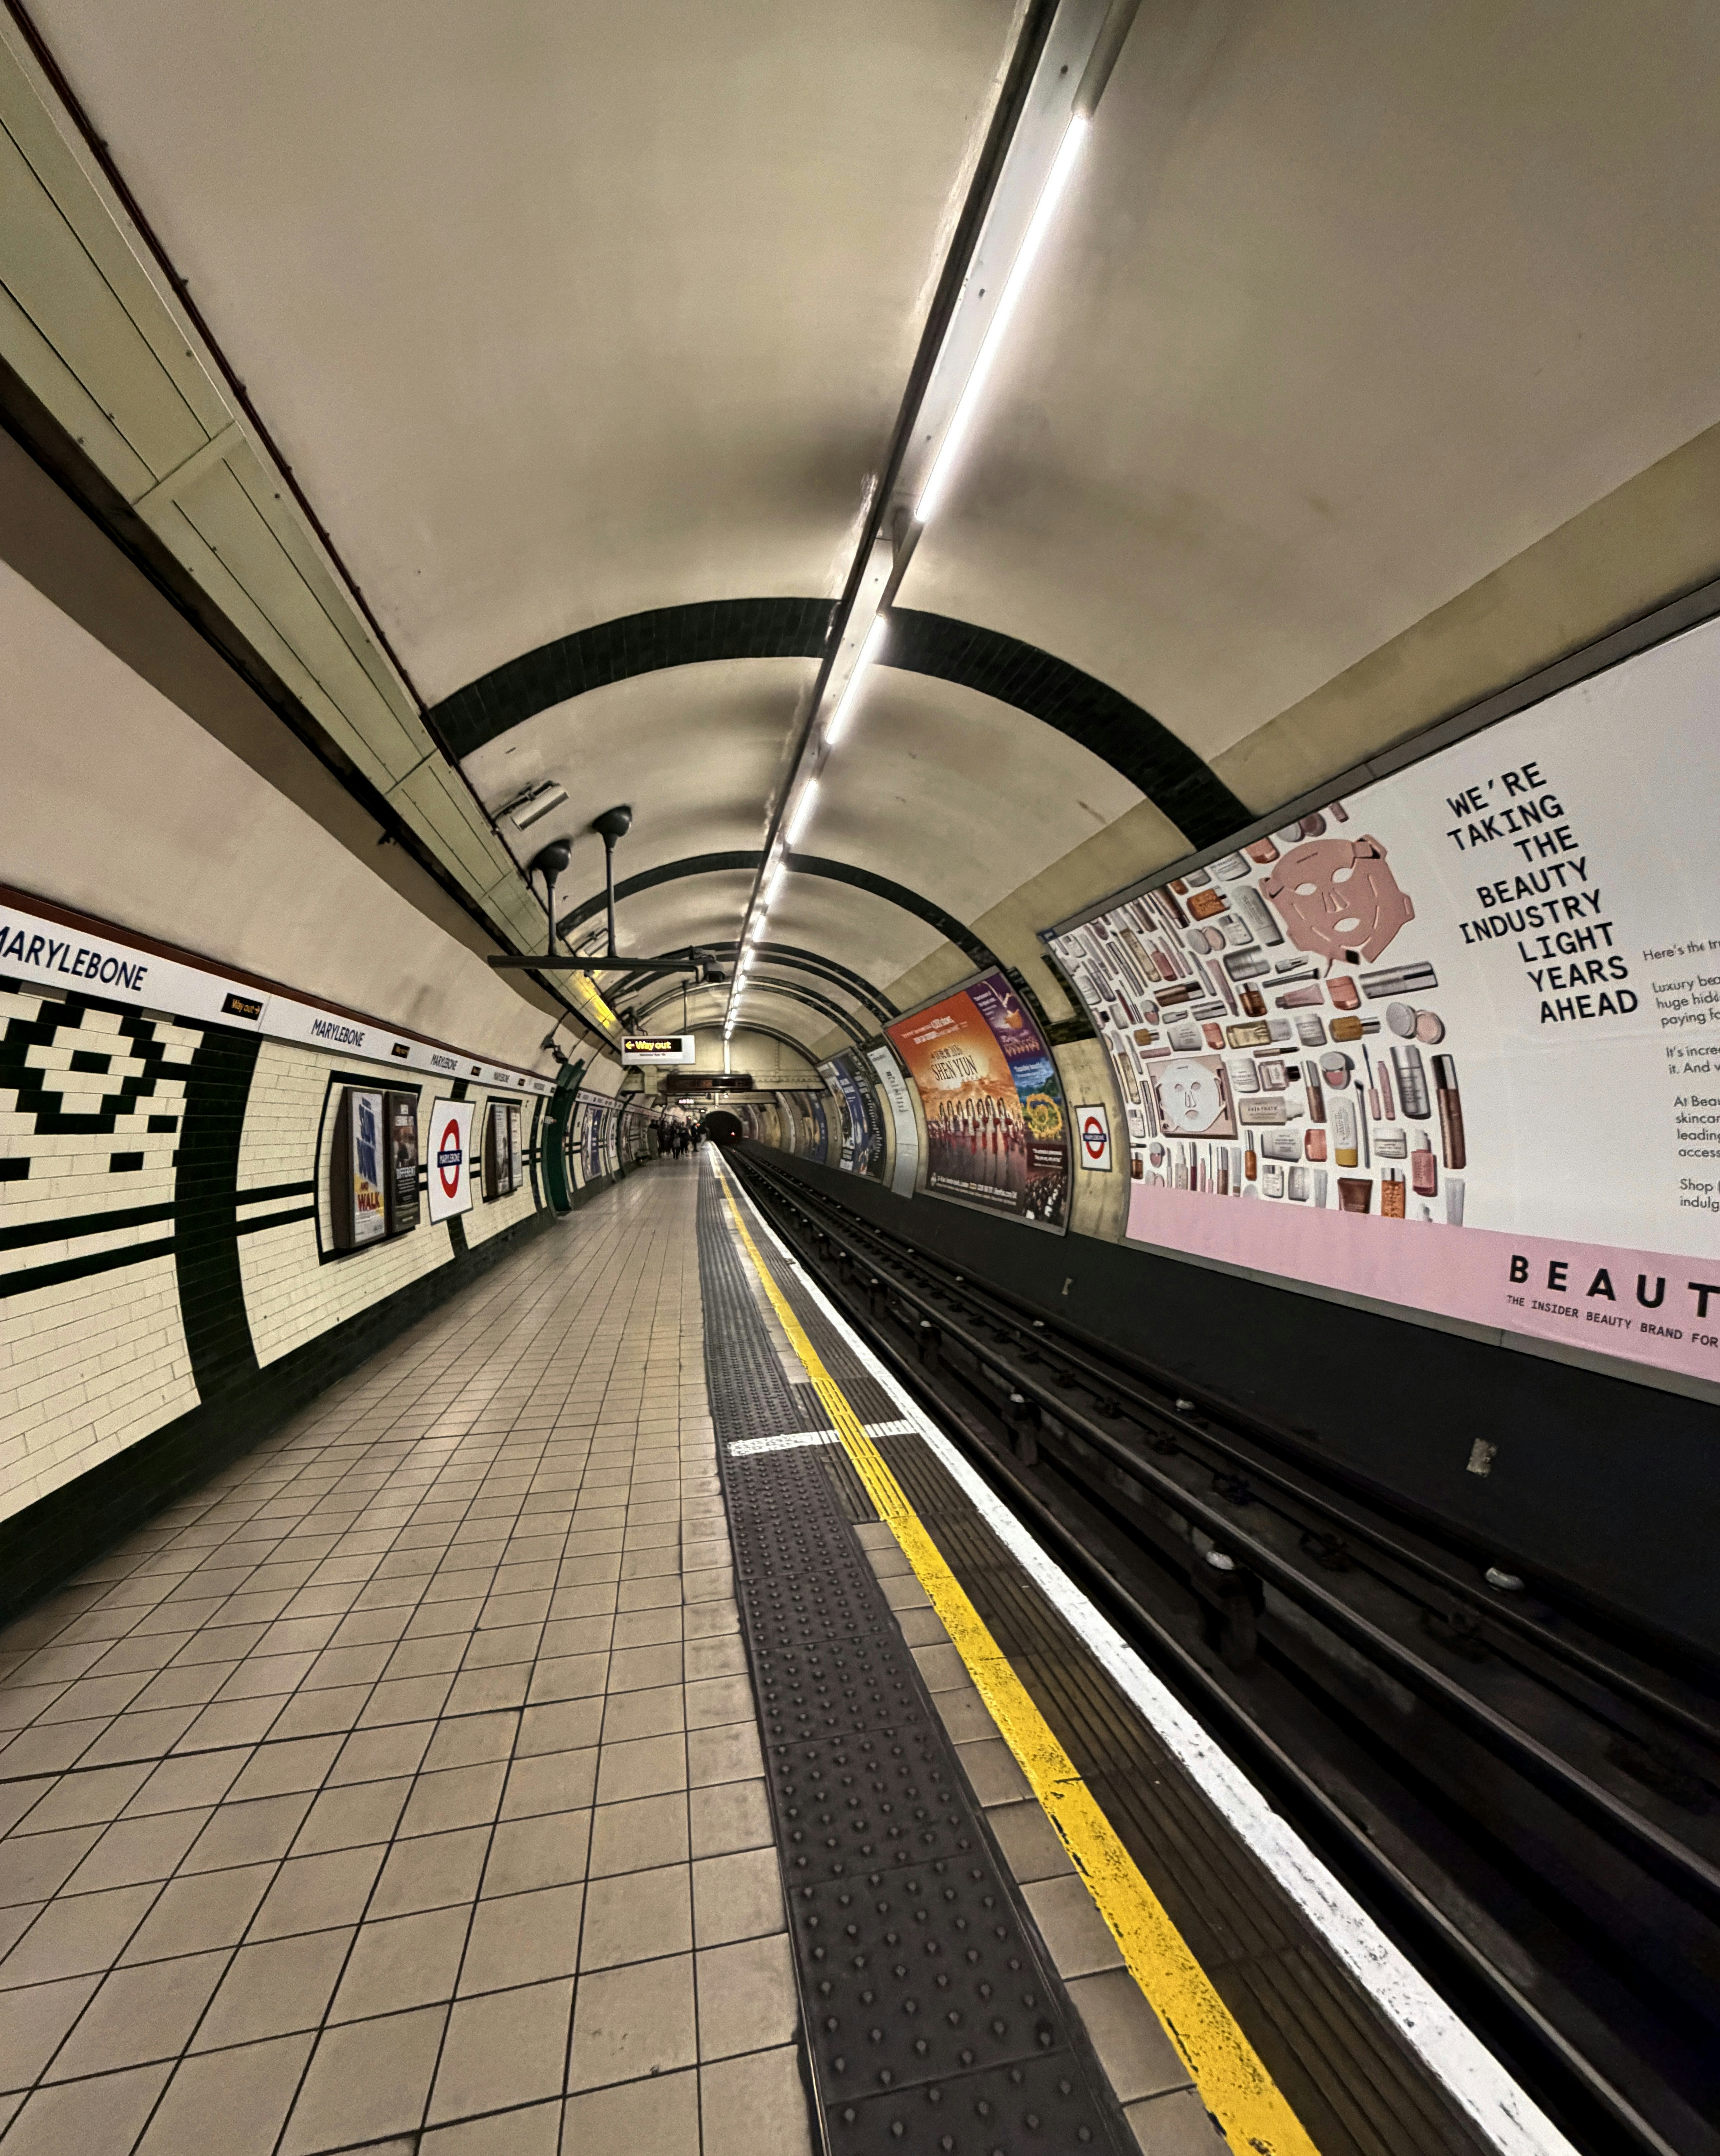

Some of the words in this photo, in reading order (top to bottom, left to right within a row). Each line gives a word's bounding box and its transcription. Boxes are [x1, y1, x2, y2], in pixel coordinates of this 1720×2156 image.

[1446, 761, 1547, 818] WE'RE
[1447, 794, 1565, 851] TAKING
[1513, 825, 1579, 862] THE
[1476, 857, 1588, 908] BEAUTY
[1459, 889, 1602, 944] INDUSTRY
[1517, 922, 1613, 963] LIGHT
[1643, 943, 1684, 960] Here's
[1687, 941, 1705, 953] the
[1708, 940, 1720, 949] tr
[1527, 955, 1628, 993] YEARS
[1652, 981, 1694, 993] Luxury
[1541, 989, 1638, 1024] AHEAD
[1656, 997, 1688, 1010] huge
[310, 1019, 365, 1047] MARYLEBONE
[1661, 1013, 1706, 1028] paying
[635, 1041, 654, 1051] Way
[1666, 1046, 1683, 1058] It's
[1685, 1046, 1720, 1057] incre
[931, 1061, 957, 1081] SHEN
[952, 1055, 978, 1077] YUN
[1683, 1060, 1710, 1074] And
[1680, 1178, 1714, 1194] Shop
[1509, 1254, 1720, 1318] BEAUT
[1507, 1295, 1525, 1307] THE
[1530, 1300, 1579, 1319] INSIDER
[1586, 1311, 1632, 1329] BEAUTY
[1640, 1323, 1683, 1340] BRAND
[1691, 1333, 1719, 1348] FOR
